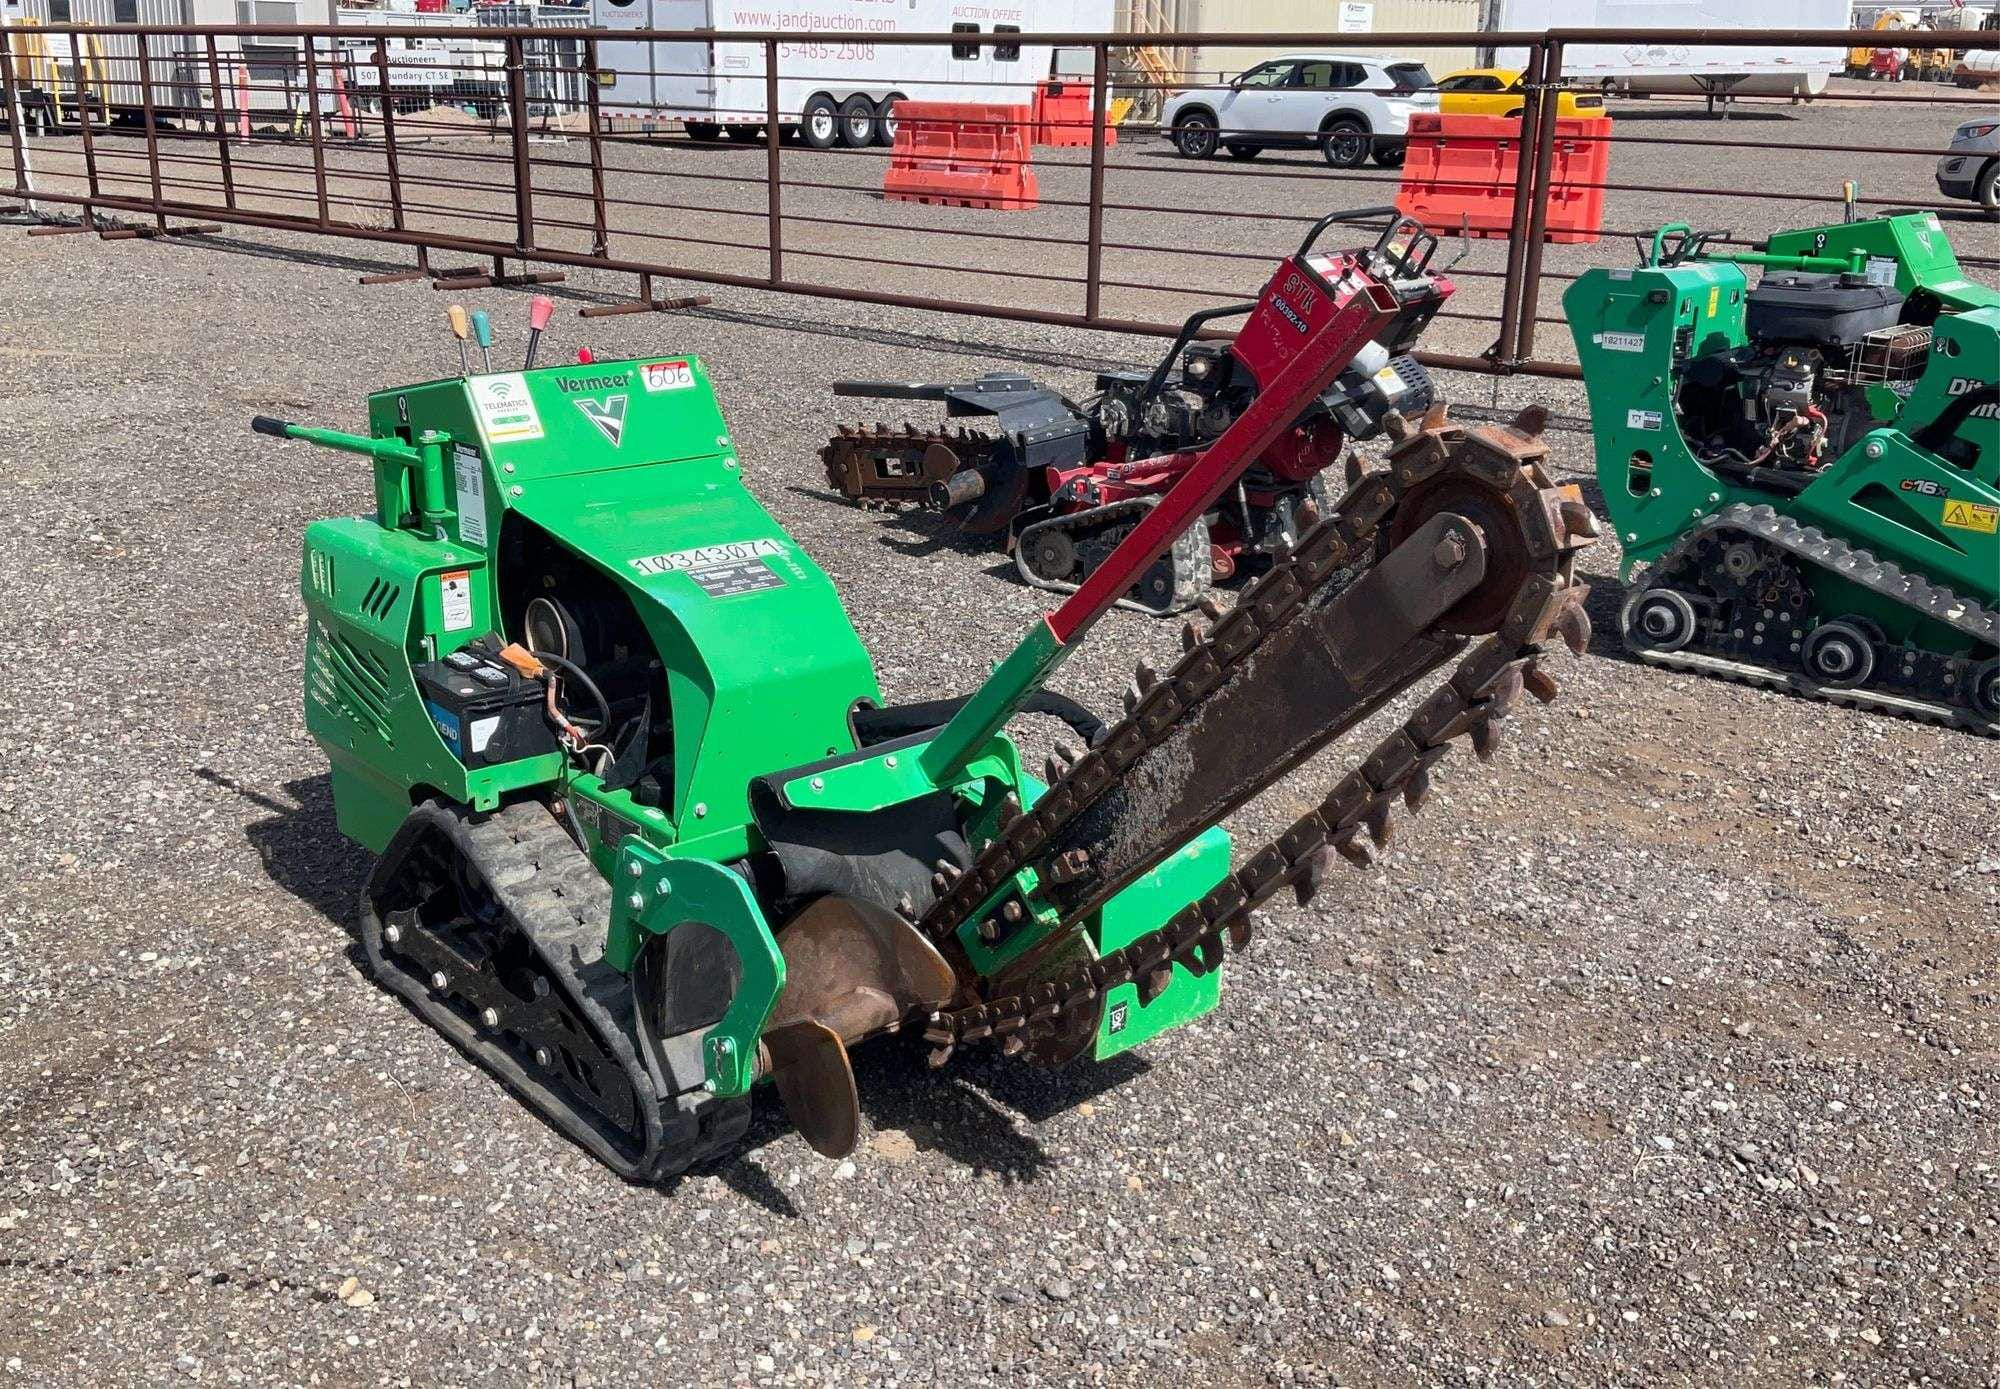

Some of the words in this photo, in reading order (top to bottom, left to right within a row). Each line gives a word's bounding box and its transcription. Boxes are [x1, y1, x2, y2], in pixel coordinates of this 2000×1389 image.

[734, 11, 896, 32] www.jandjauction.com
[952, 6, 990, 19] AUCTION
[992, 8, 1022, 21] OFFICE
[760, 38, 875, 61] 55-485-2508
[1283, 273, 1318, 315] STK
[555, 374, 630, 393] Vermeer
[649, 364, 690, 388] 606
[483, 399, 529, 411] TELEMATICS
[634, 540, 779, 574] 10343071
